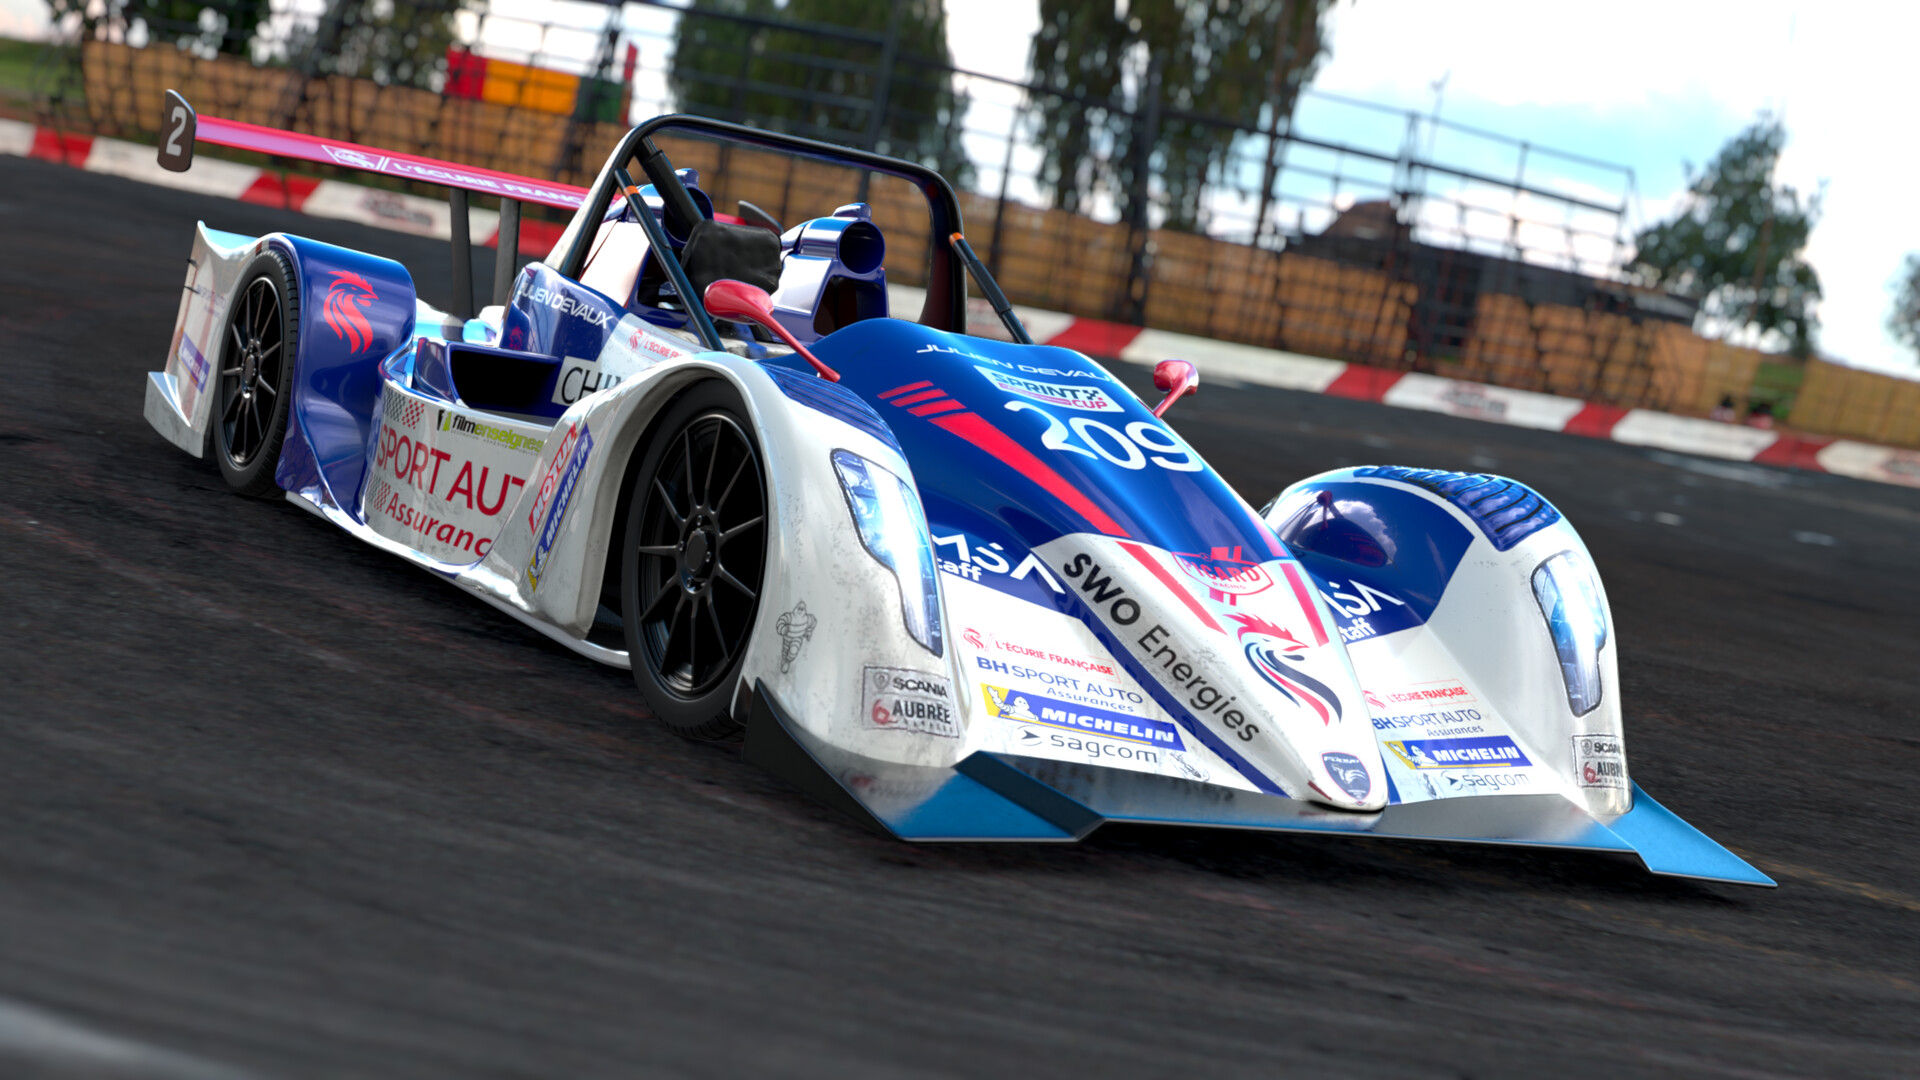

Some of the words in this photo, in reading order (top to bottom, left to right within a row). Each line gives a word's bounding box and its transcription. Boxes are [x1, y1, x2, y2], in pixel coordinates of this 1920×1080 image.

[166, 106, 187, 157] 2
[551, 294, 613, 329] DEVAUX
[917, 344, 1013, 370] JULIEN
[990, 372, 1080, 400] SPRINT
[1072, 399, 1108, 409] CUP
[452, 414, 545, 453] filmenseignes
[1004, 400, 1204, 472] 209
[377, 424, 451, 495] SPORT
[532, 430, 577, 527] MOTUL
[546, 433, 589, 548] MICHELIN
[1179, 558, 1260, 582] PICARD
[995, 640, 1046, 660] L'ÉCURIE
[1048, 653, 1115, 676] FRANÇAISE
[1063, 553, 1141, 625] SWO
[1137, 624, 1260, 742] Energies
[893, 676, 948, 698] SCANIA
[976, 656, 1009, 675] BH
[1011, 664, 1080, 691] SPORT
[1086, 682, 1143, 704] AUTO
[1046, 687, 1134, 713] Assurances
[1041, 706, 1174, 743] MICHELIN
[1393, 712, 1441, 728] SPORT
[1442, 708, 1481, 724] AUTO
[1427, 725, 1484, 737] Assurances
[1050, 734, 1158, 764] sagcom
[1432, 745, 1520, 762] MICHELIN
[1462, 773, 1530, 791] sagcom
